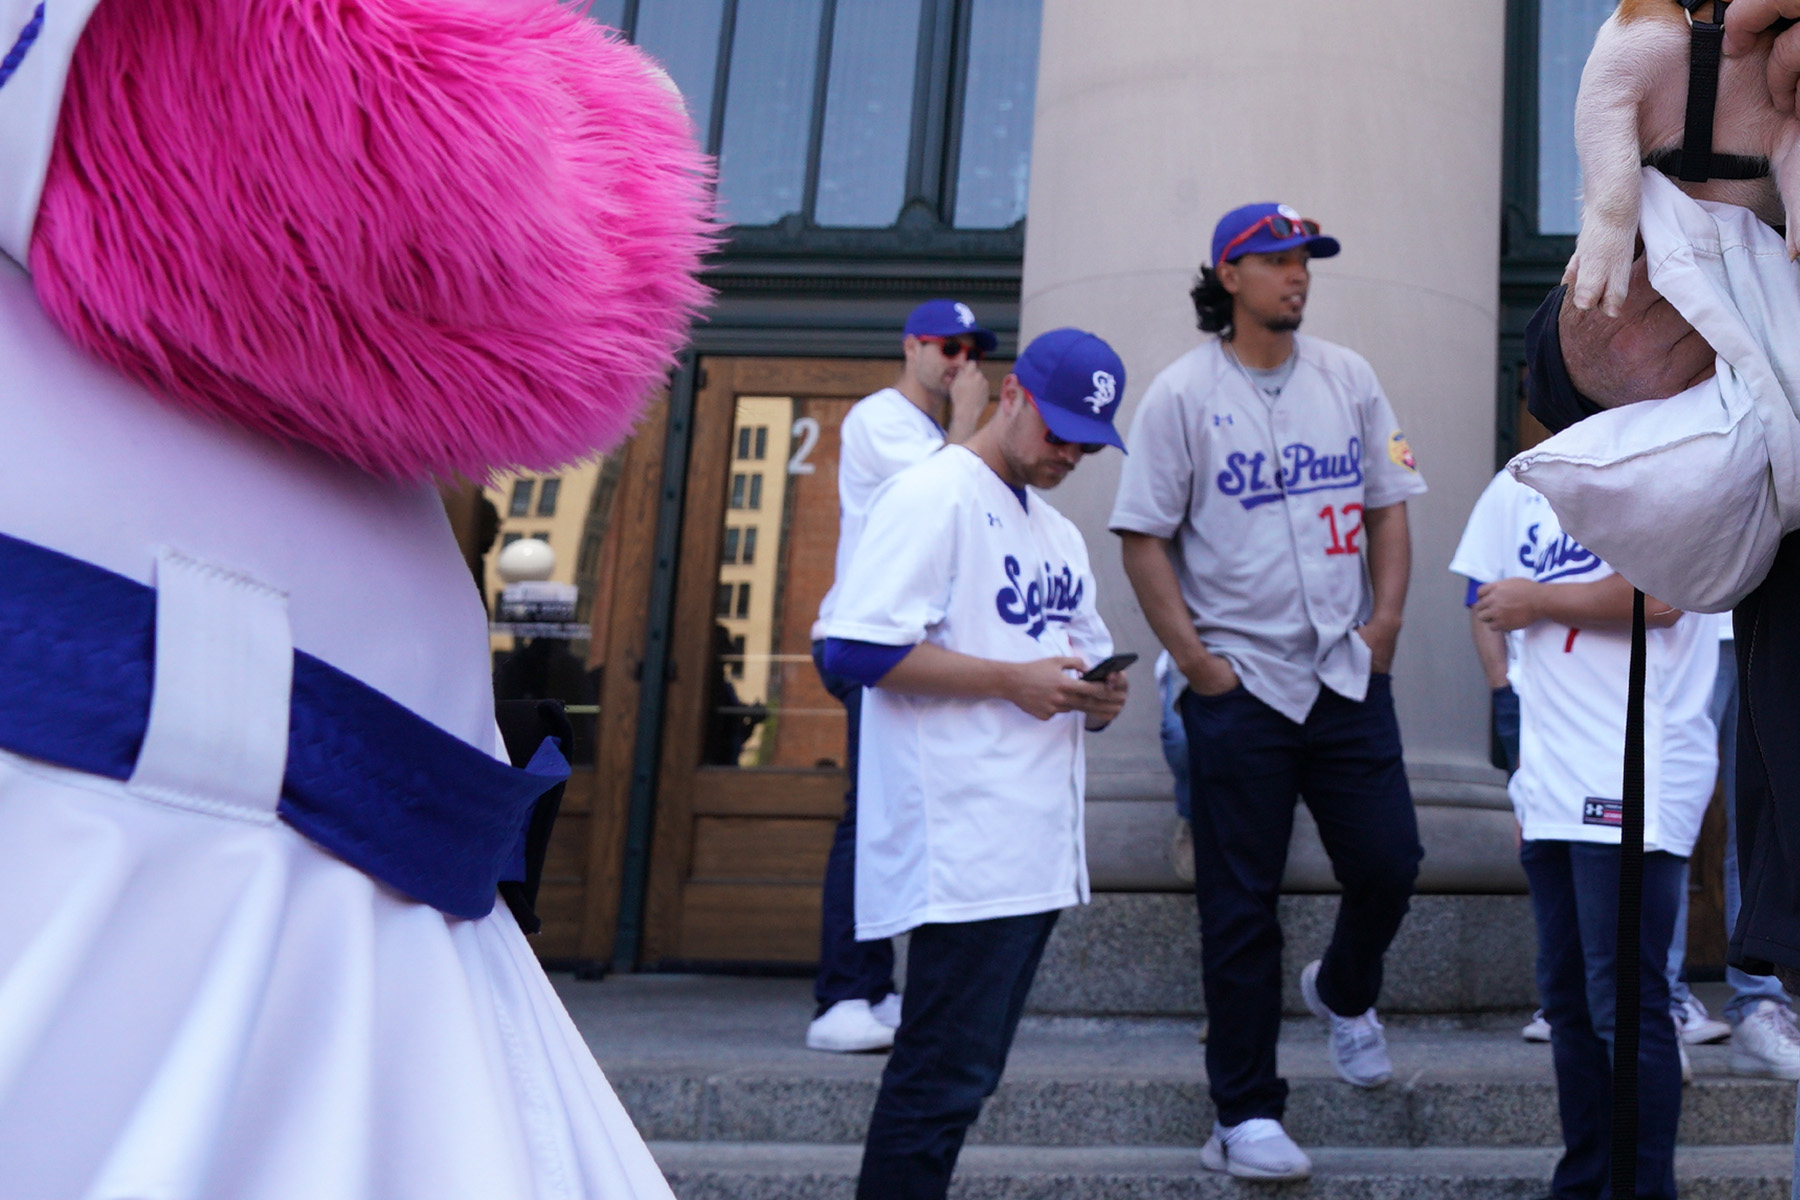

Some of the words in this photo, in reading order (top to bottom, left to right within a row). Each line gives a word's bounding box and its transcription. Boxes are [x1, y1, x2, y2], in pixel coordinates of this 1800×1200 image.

[788, 417, 820, 474] 2
[1274, 436, 1363, 488] Paul
[1318, 503, 1365, 556] 12
